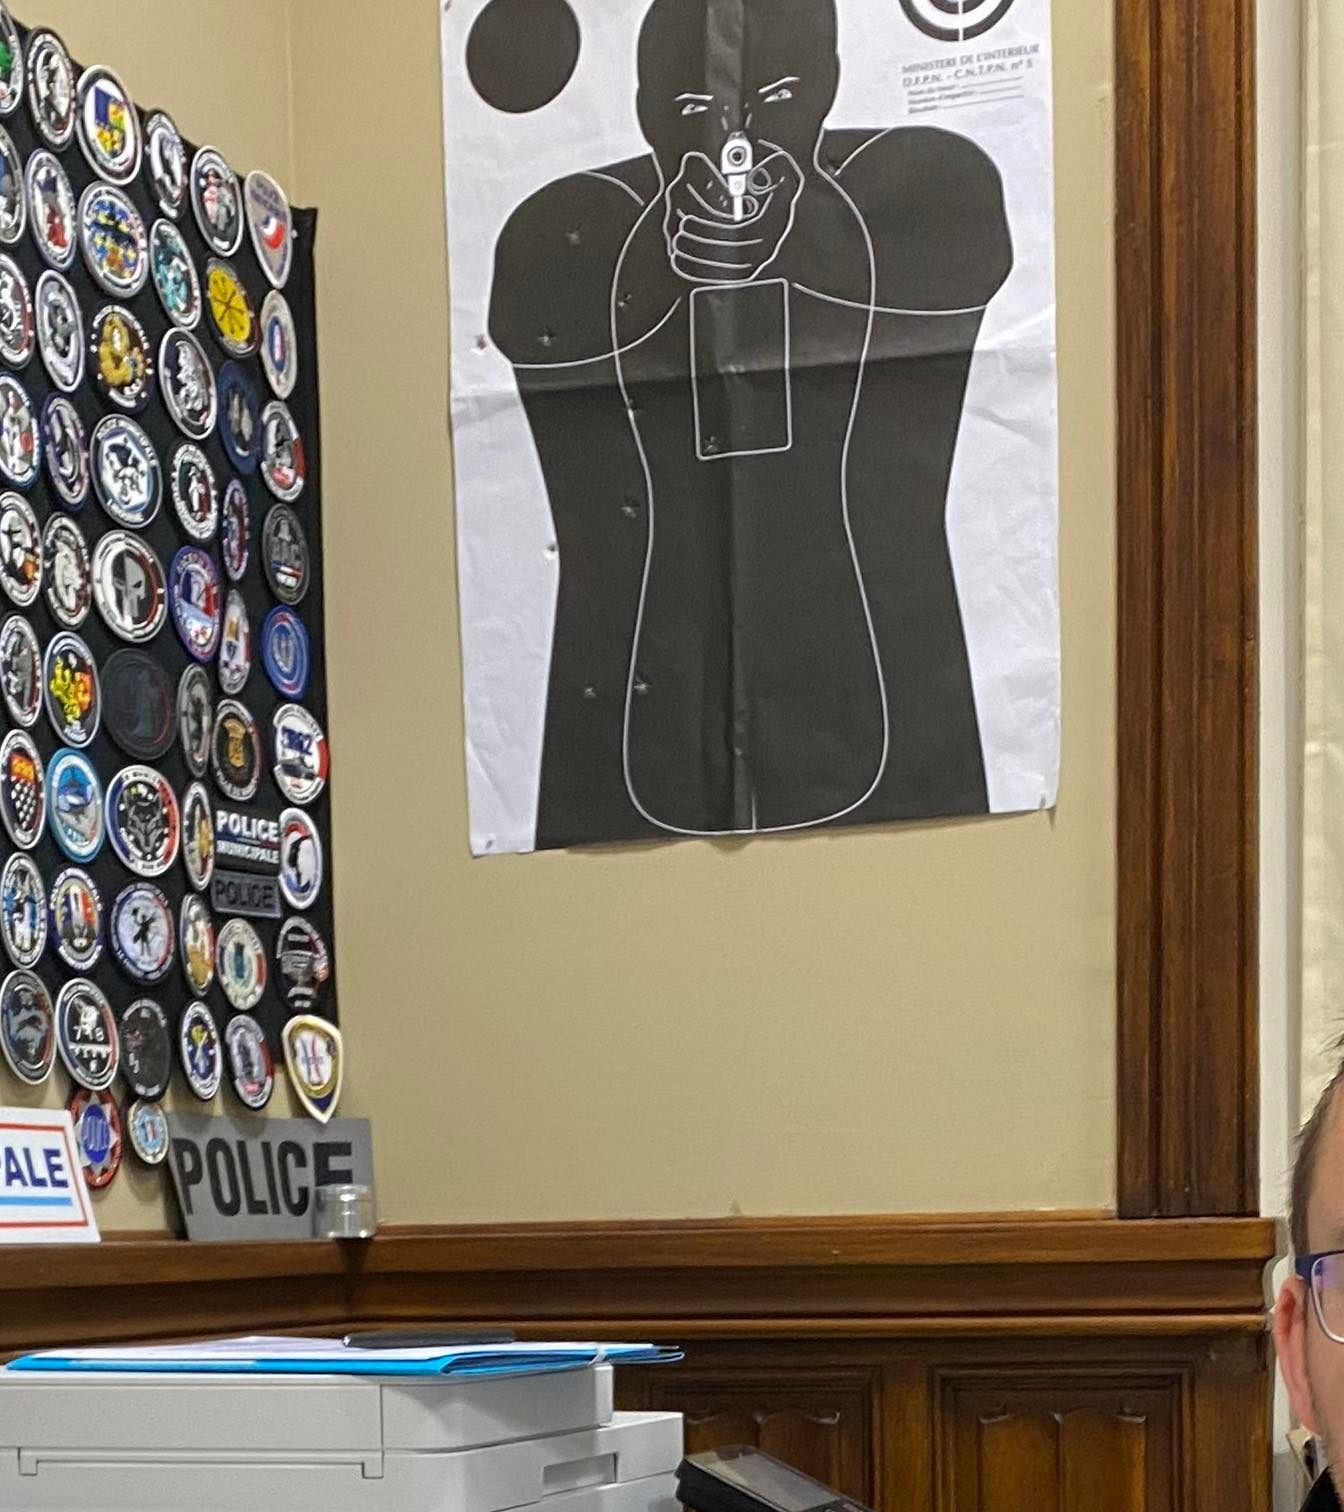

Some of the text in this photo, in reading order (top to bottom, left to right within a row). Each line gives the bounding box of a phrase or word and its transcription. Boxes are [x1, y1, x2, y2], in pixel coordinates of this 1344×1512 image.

[959, 54, 974, 66] DE
[216, 810, 279, 842] POLICE
[216, 840, 280, 865] MUNICIPALE
[215, 877, 275, 906] POLICE
[172, 1137, 353, 1217] POLICE
